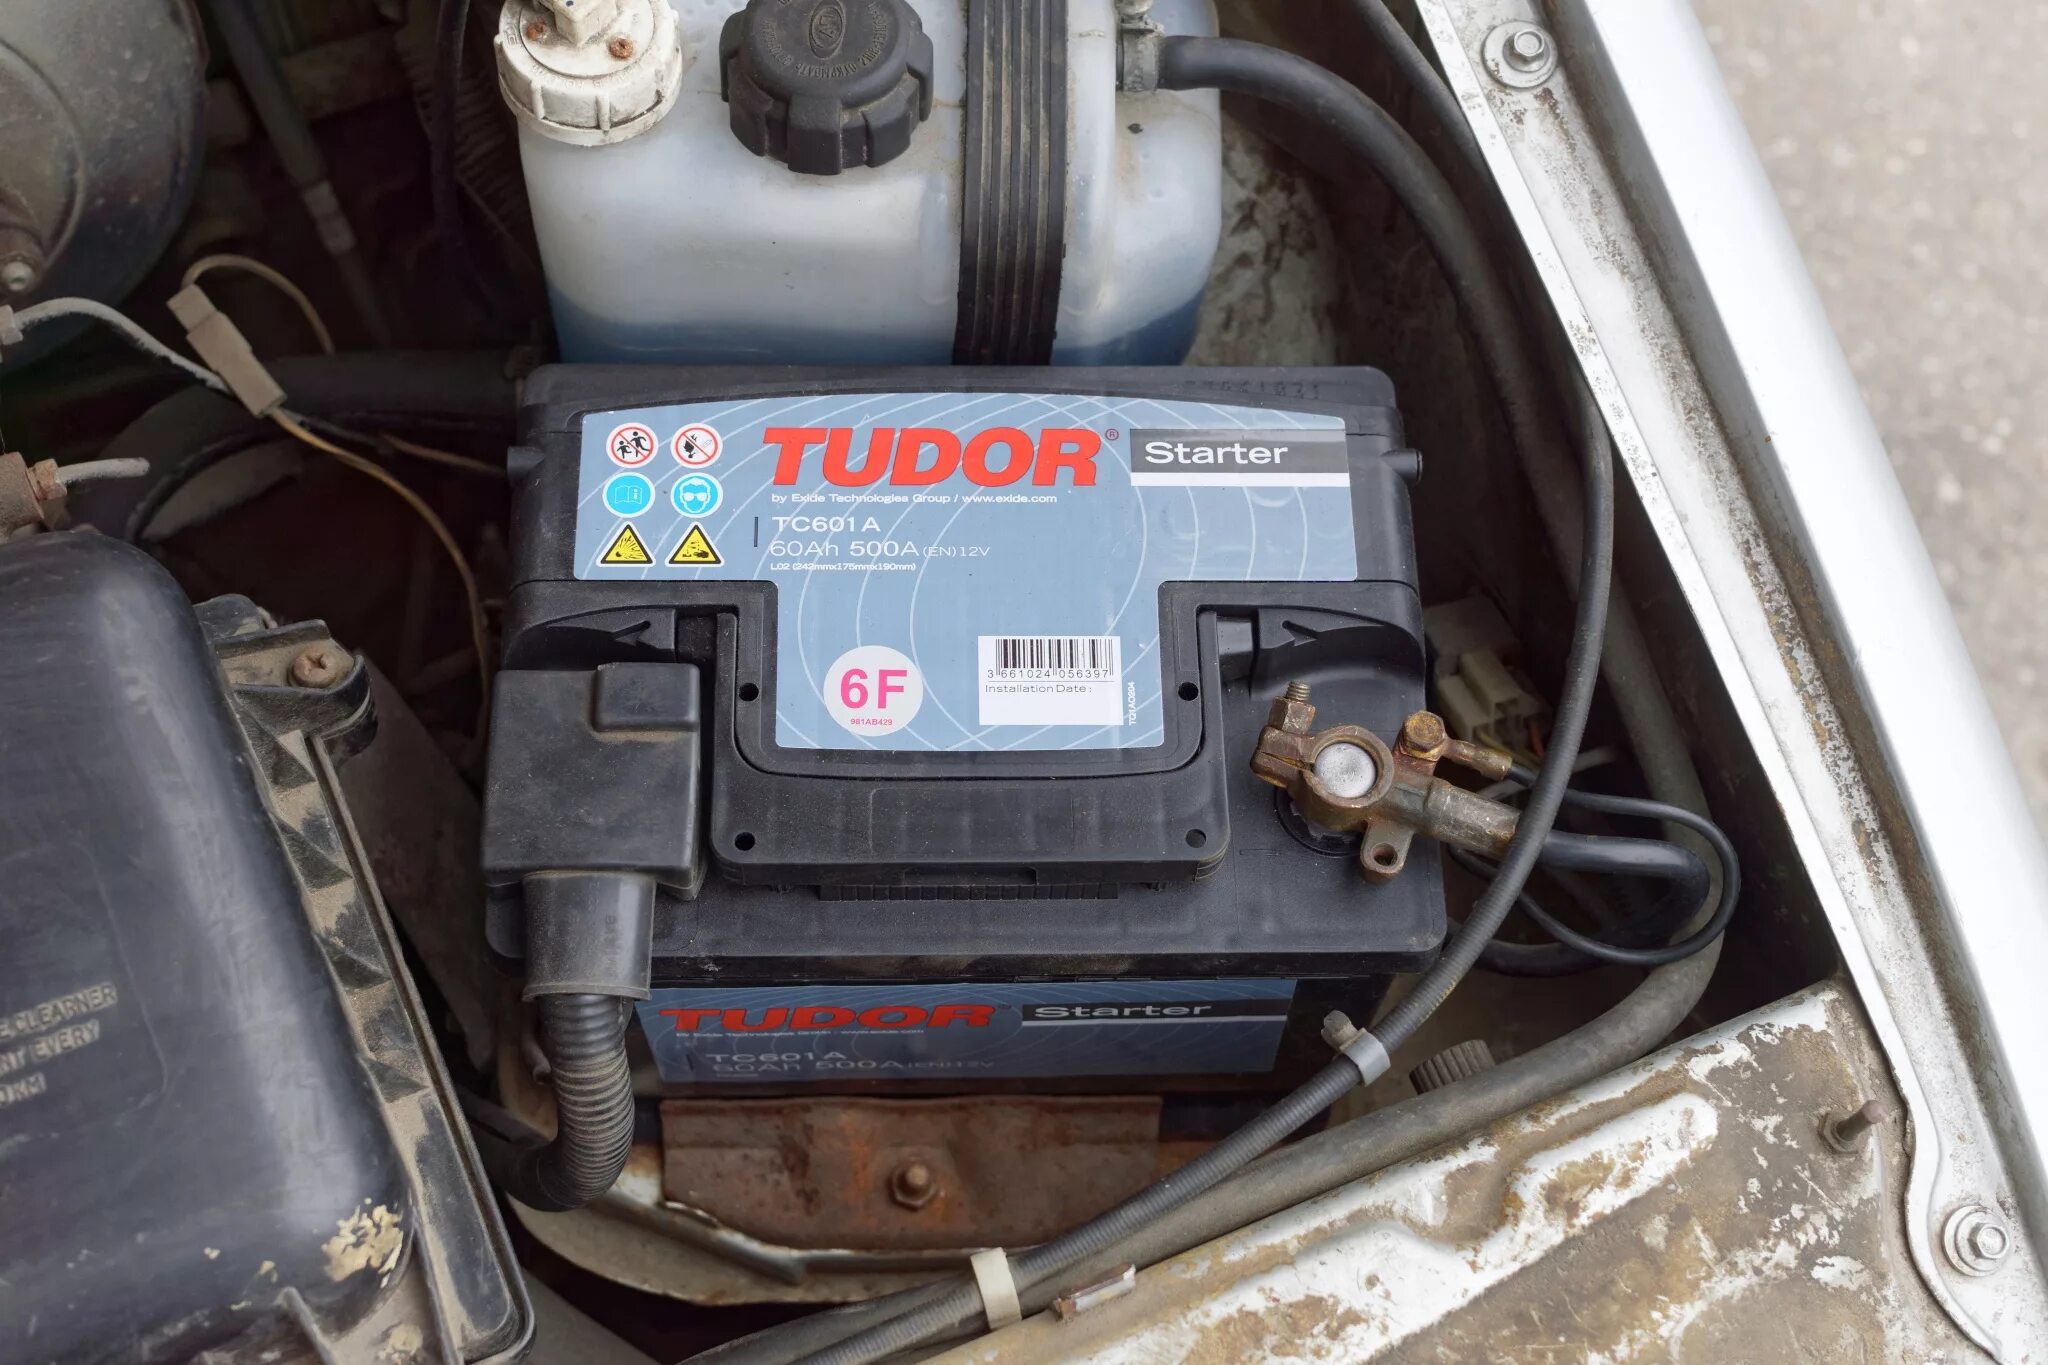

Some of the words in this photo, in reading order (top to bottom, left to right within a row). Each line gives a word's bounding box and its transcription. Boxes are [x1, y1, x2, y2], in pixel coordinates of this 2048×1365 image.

[762, 426, 1102, 487] TUDOR
[1145, 441, 1289, 465] Starter
[771, 493, 787, 504] by
[791, 493, 826, 503] Exide
[829, 493, 909, 504] Technologies
[912, 493, 951, 505] Group
[953, 493, 959, 503] /
[961, 493, 1058, 504] www.exide.com
[770, 540, 839, 557] 60Ah
[987, 669, 994, 679] 3
[1000, 669, 1051, 679] 661024
[1059, 669, 1109, 679] 056397
[840, 668, 908, 709] 6F
[985, 684, 1054, 693] Installation
[659, 1004, 996, 1032] TUDOR
[1035, 1004, 1212, 1018] Starter
[33, 1022, 99, 1060] EVERY
